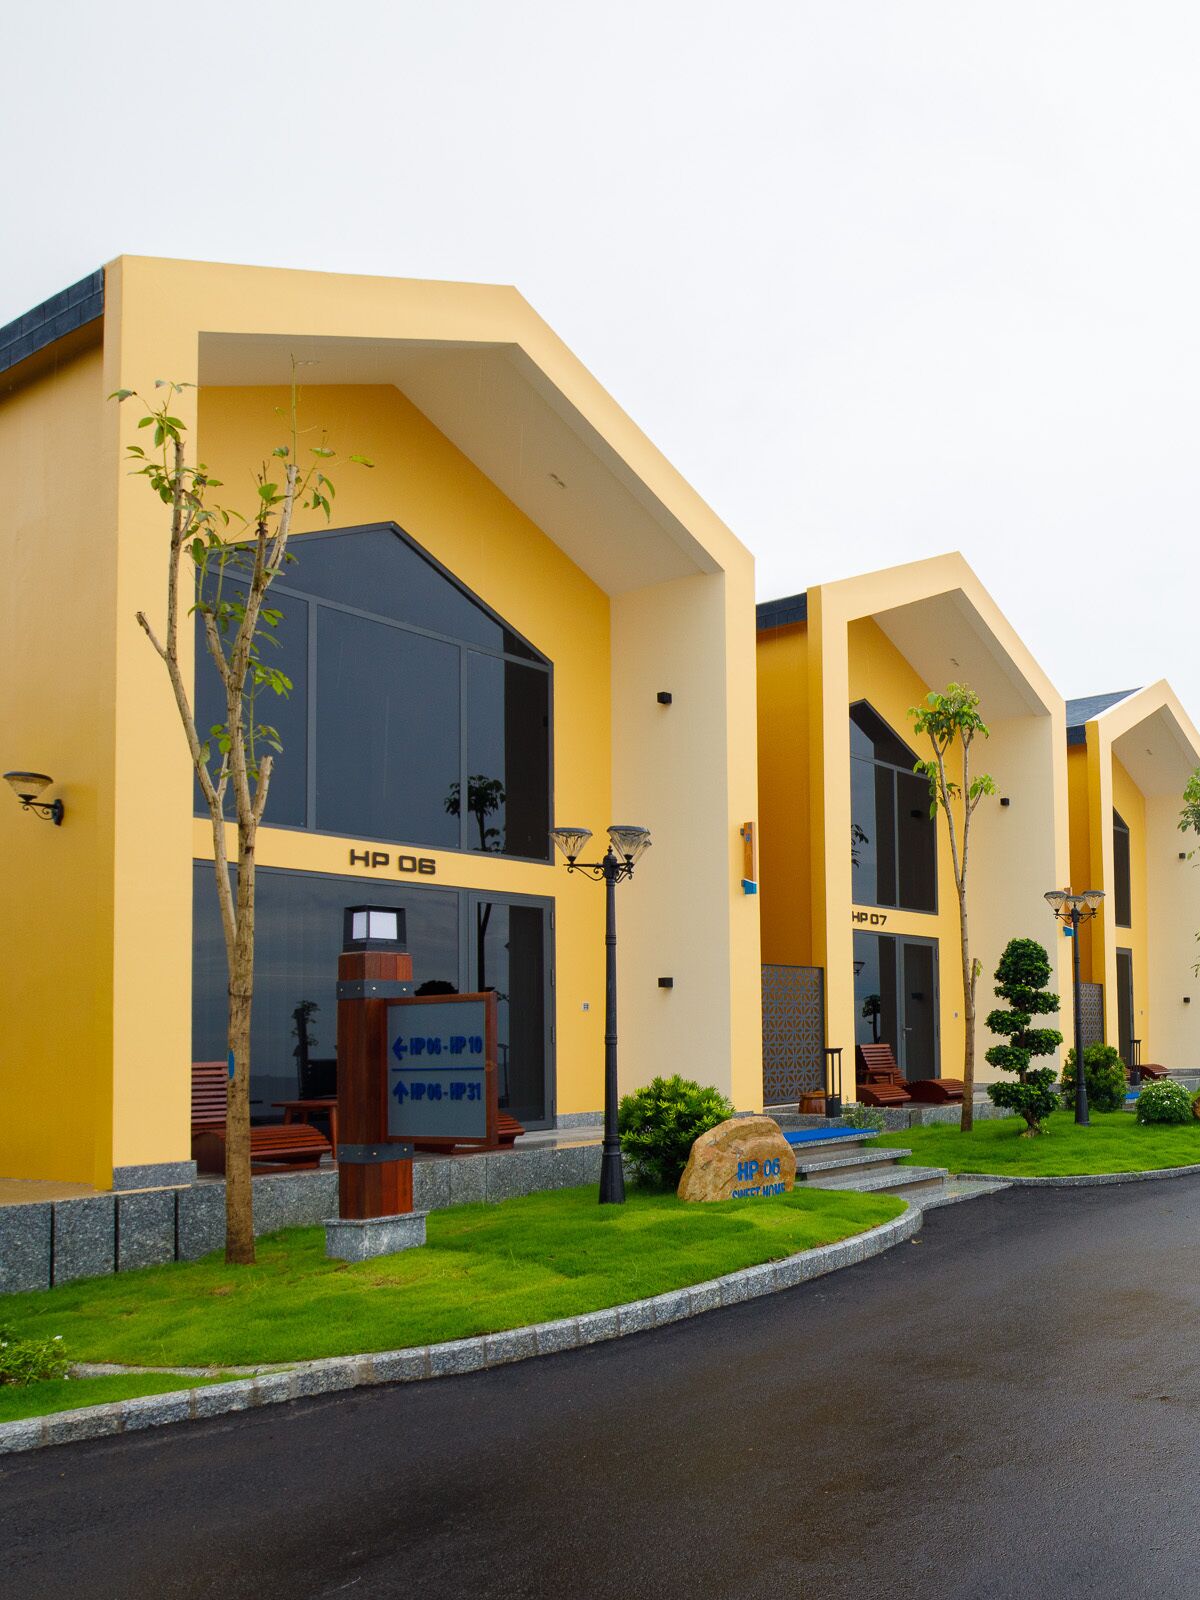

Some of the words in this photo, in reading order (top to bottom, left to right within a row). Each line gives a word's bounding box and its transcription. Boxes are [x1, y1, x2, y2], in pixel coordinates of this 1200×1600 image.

[350, 848, 389, 868] HP
[398, 855, 436, 875] 06
[852, 910, 868, 923] HP
[870, 913, 887, 926] 07
[737, 1160, 758, 1181] HP
[763, 1157, 780, 1177] 06
